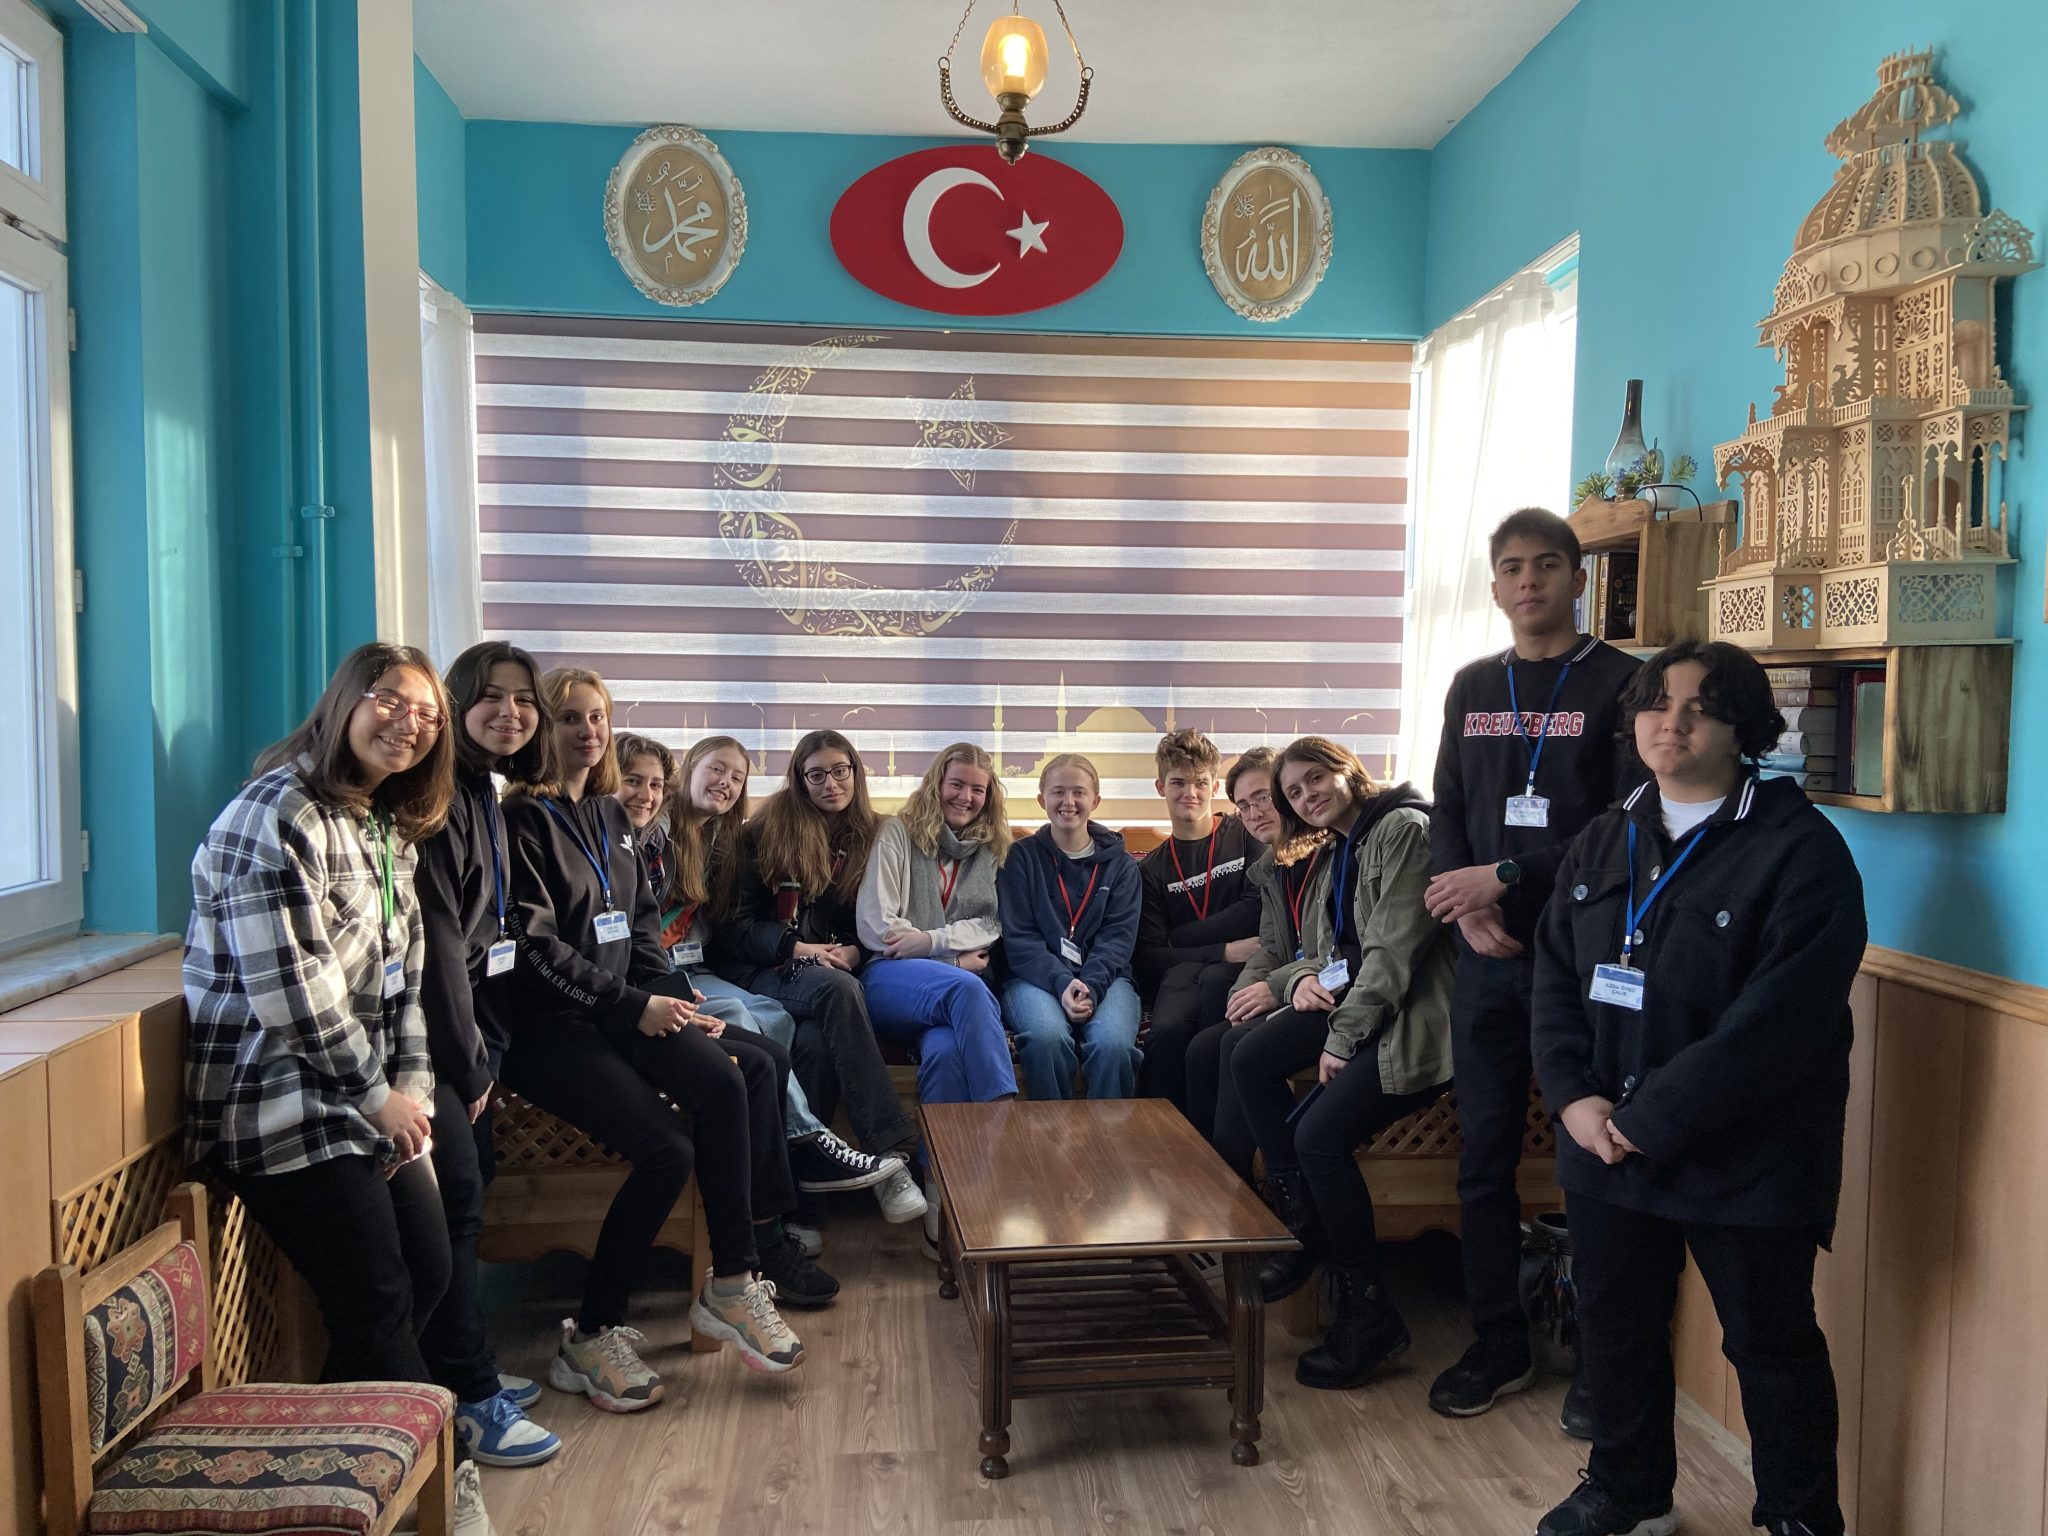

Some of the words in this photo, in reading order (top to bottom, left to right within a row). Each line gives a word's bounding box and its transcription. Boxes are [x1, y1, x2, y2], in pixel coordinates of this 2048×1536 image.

[1236, 187, 1301, 286] الله
[1464, 711, 1585, 737] KREUZBERG
[1173, 882, 1190, 893] THE
[1191, 870, 1219, 888] NORH
[1220, 862, 1244, 876] FACE
[527, 949, 567, 990] BİLİMLER
